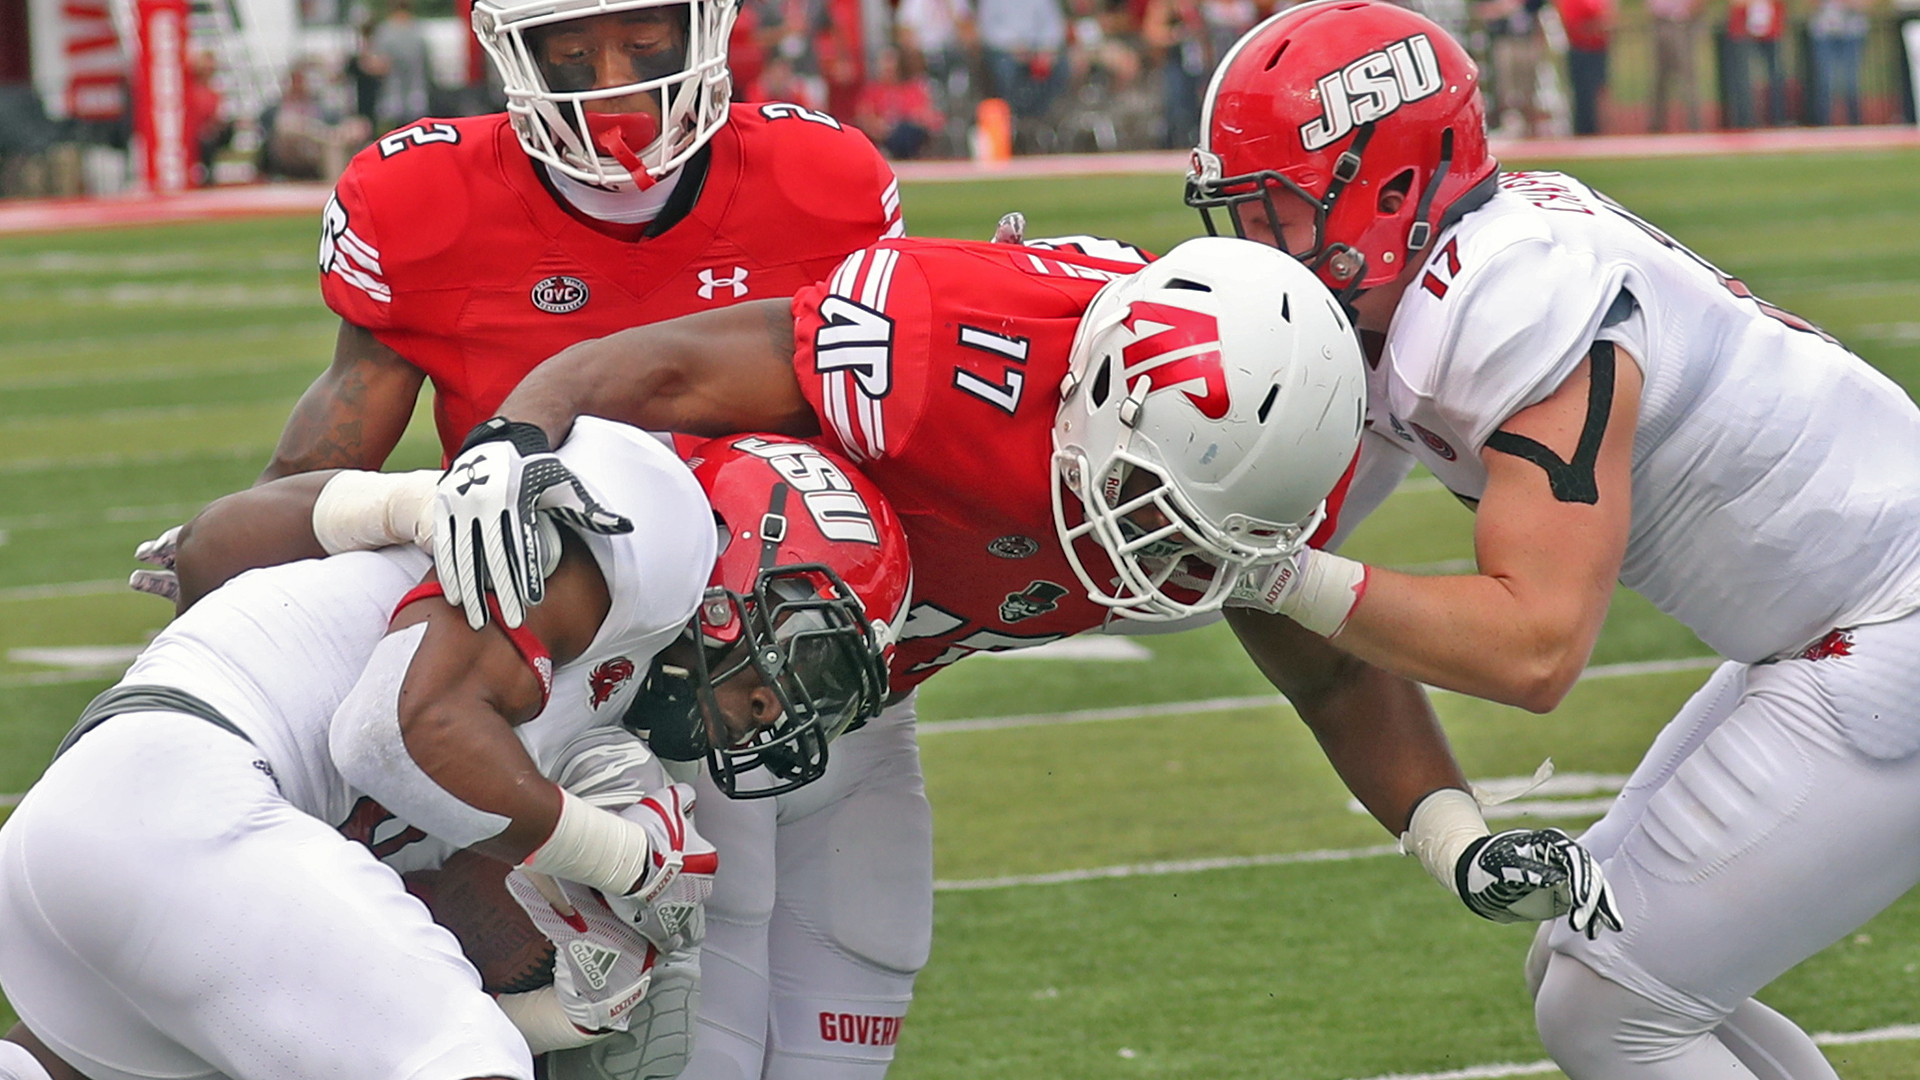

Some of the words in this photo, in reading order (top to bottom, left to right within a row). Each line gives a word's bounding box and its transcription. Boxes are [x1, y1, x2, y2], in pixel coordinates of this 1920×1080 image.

[761, 103, 841, 130] 2
[1299, 34, 1443, 151] JSU
[380, 123, 460, 159] 2
[543, 287, 575, 302] OVC
[1420, 234, 1462, 301] 17
[953, 323, 1031, 416] 17
[731, 433, 880, 545] JSU
[571, 944, 604, 988] adidas
